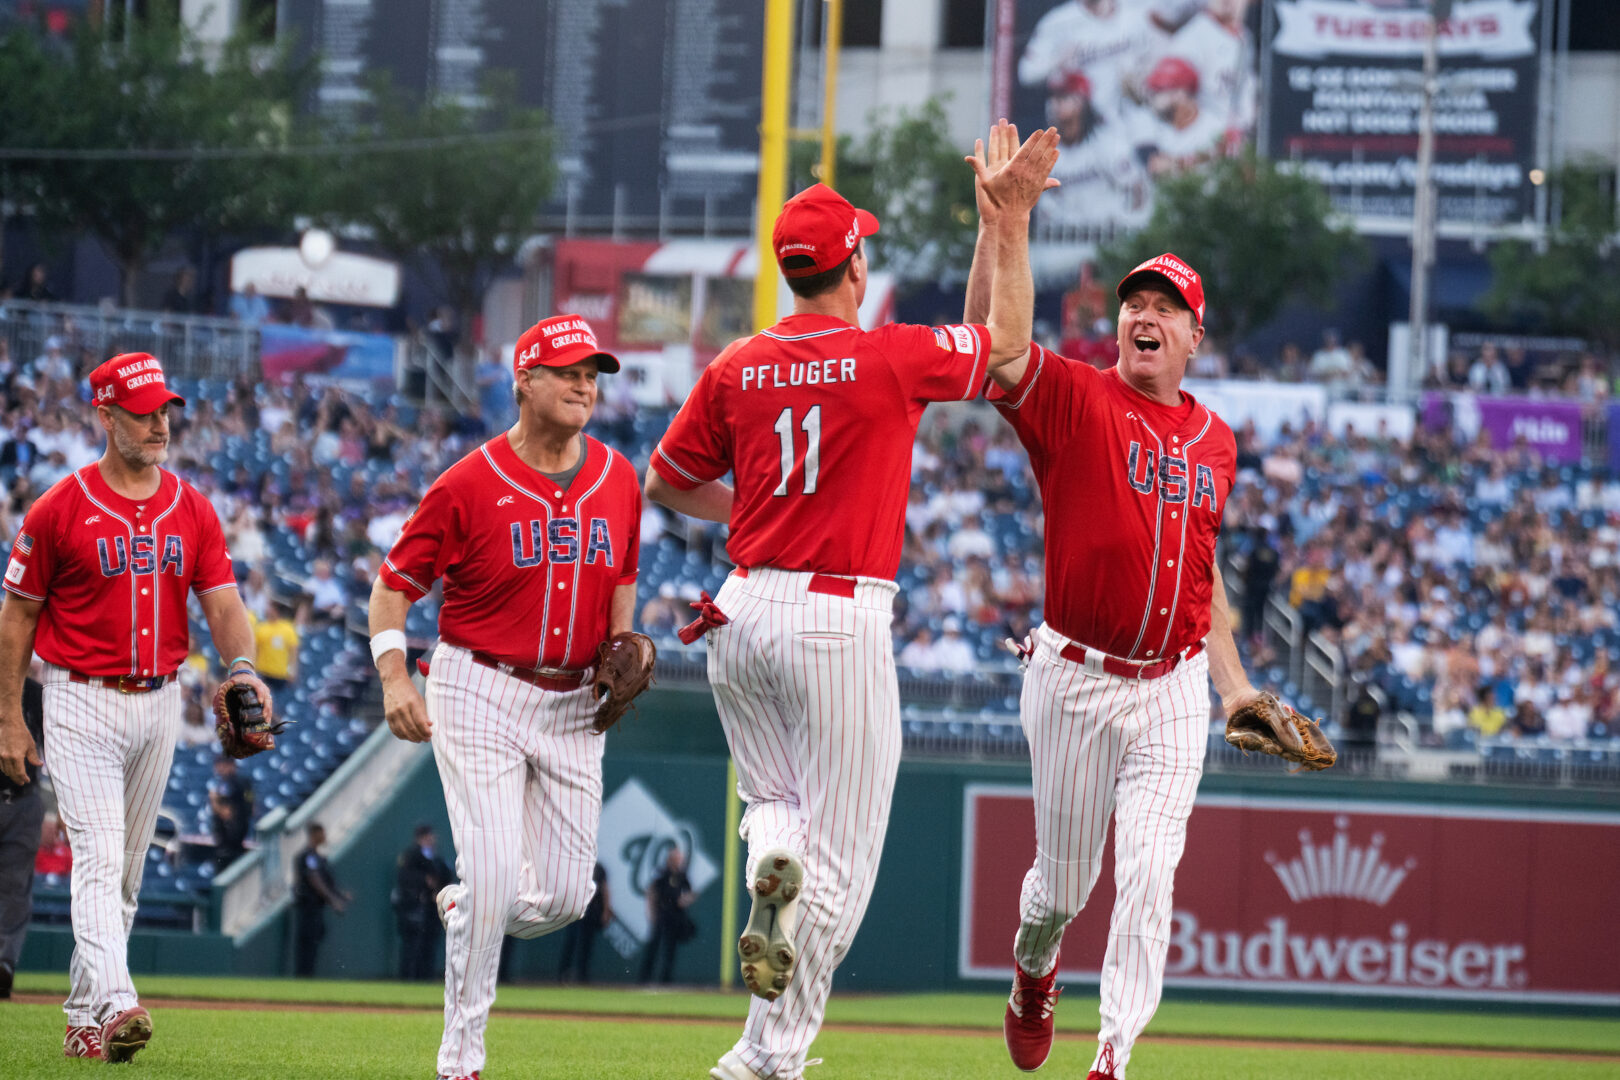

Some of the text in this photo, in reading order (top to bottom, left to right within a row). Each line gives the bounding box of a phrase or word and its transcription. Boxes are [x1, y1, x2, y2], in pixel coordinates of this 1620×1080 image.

[1156, 256, 1197, 284] AMERICA
[1163, 269, 1190, 290] AGAIN
[541, 321, 571, 337] MAKE
[552, 333, 582, 349] GREAT
[117, 361, 143, 379] MAKE
[126, 373, 153, 390] GREAT
[741, 358, 857, 391] PFLUGER
[772, 403, 822, 497] 11
[1127, 440, 1217, 513] USA
[96, 534, 184, 578] USA
[510, 517, 614, 569] USA
[1164, 909, 1526, 989] Budweiser
